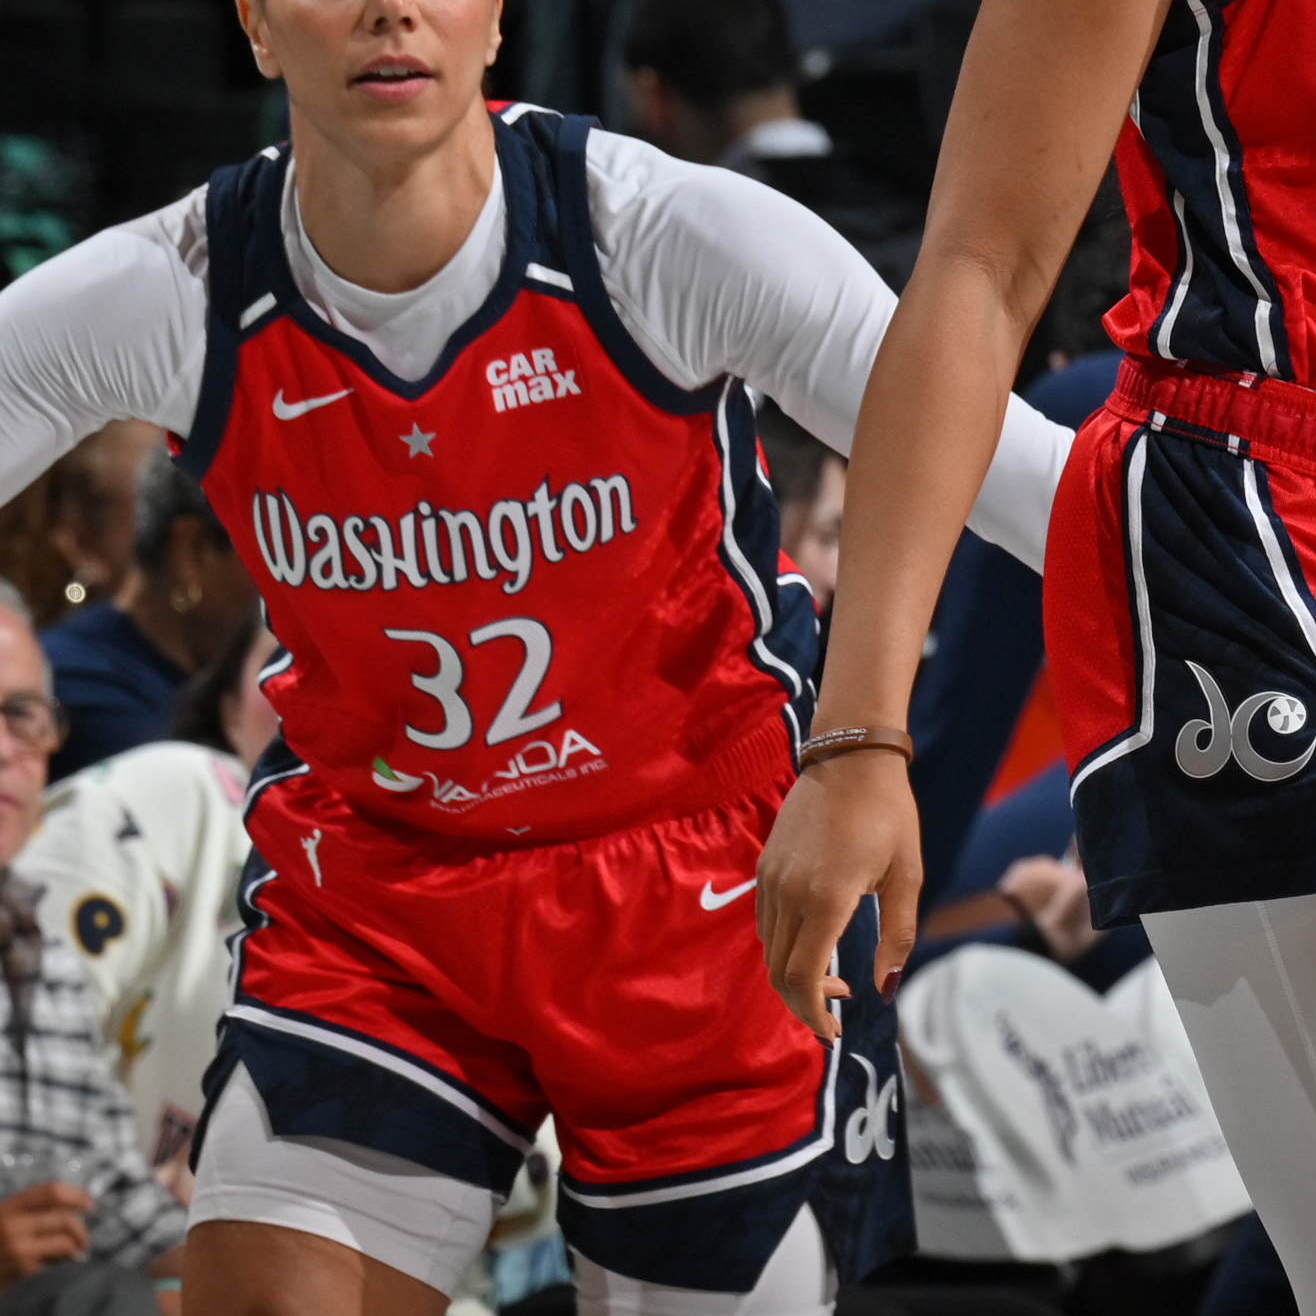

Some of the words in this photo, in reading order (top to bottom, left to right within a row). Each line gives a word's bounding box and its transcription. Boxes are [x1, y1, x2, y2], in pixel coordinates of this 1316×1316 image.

[486, 348, 559, 386] CAR
[491, 370, 582, 413] max
[251, 473, 639, 596] Washington
[383, 616, 564, 750] 32
